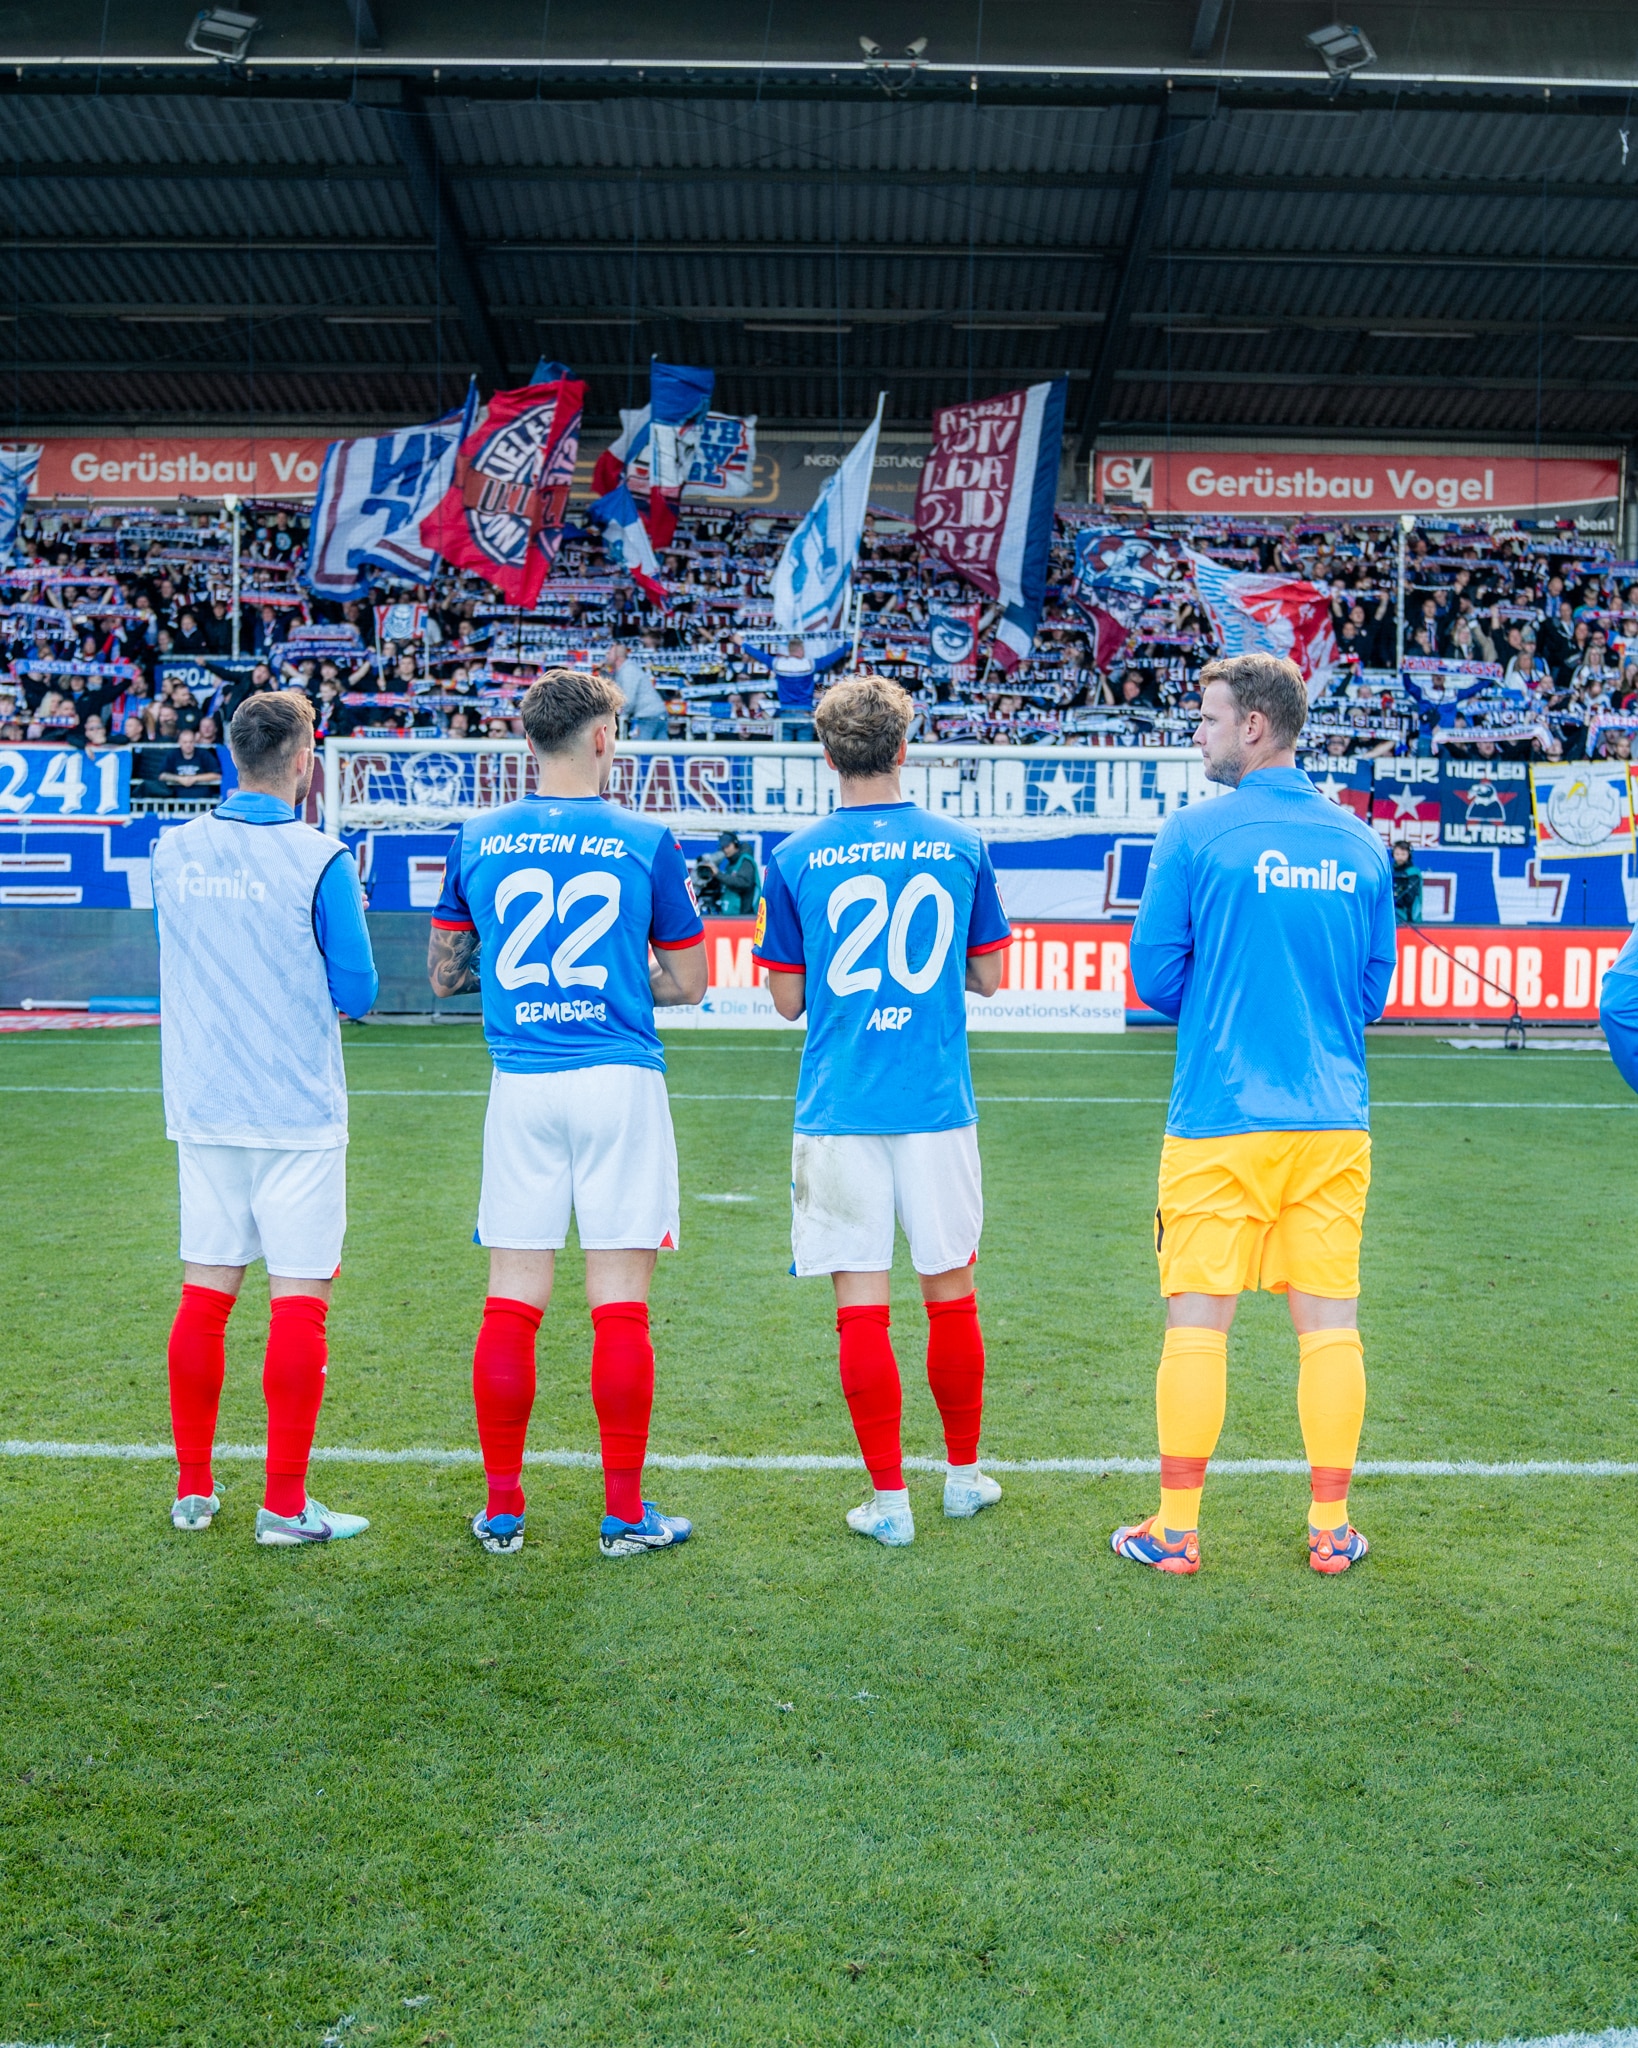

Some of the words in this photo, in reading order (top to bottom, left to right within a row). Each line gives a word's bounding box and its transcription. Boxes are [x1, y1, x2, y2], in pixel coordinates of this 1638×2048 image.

[70, 452, 257, 484] Gerüstbau
[1186, 466, 1374, 500] Gerüstbau
[1386, 469, 1495, 508] Vogel
[1374, 757, 1440, 783] FOR
[480, 833, 576, 857] HOLSTEIN
[580, 836, 628, 860] KIEL
[1444, 822, 1526, 846] ULTRAS
[809, 841, 906, 869] HOLSTEIN
[912, 841, 956, 861] KIEL
[176, 861, 266, 904] famila
[1253, 849, 1357, 893] famila
[494, 867, 622, 991] 22
[826, 872, 955, 998] 20
[720, 1001, 748, 1015] Die
[865, 1007, 913, 1031] ARP
